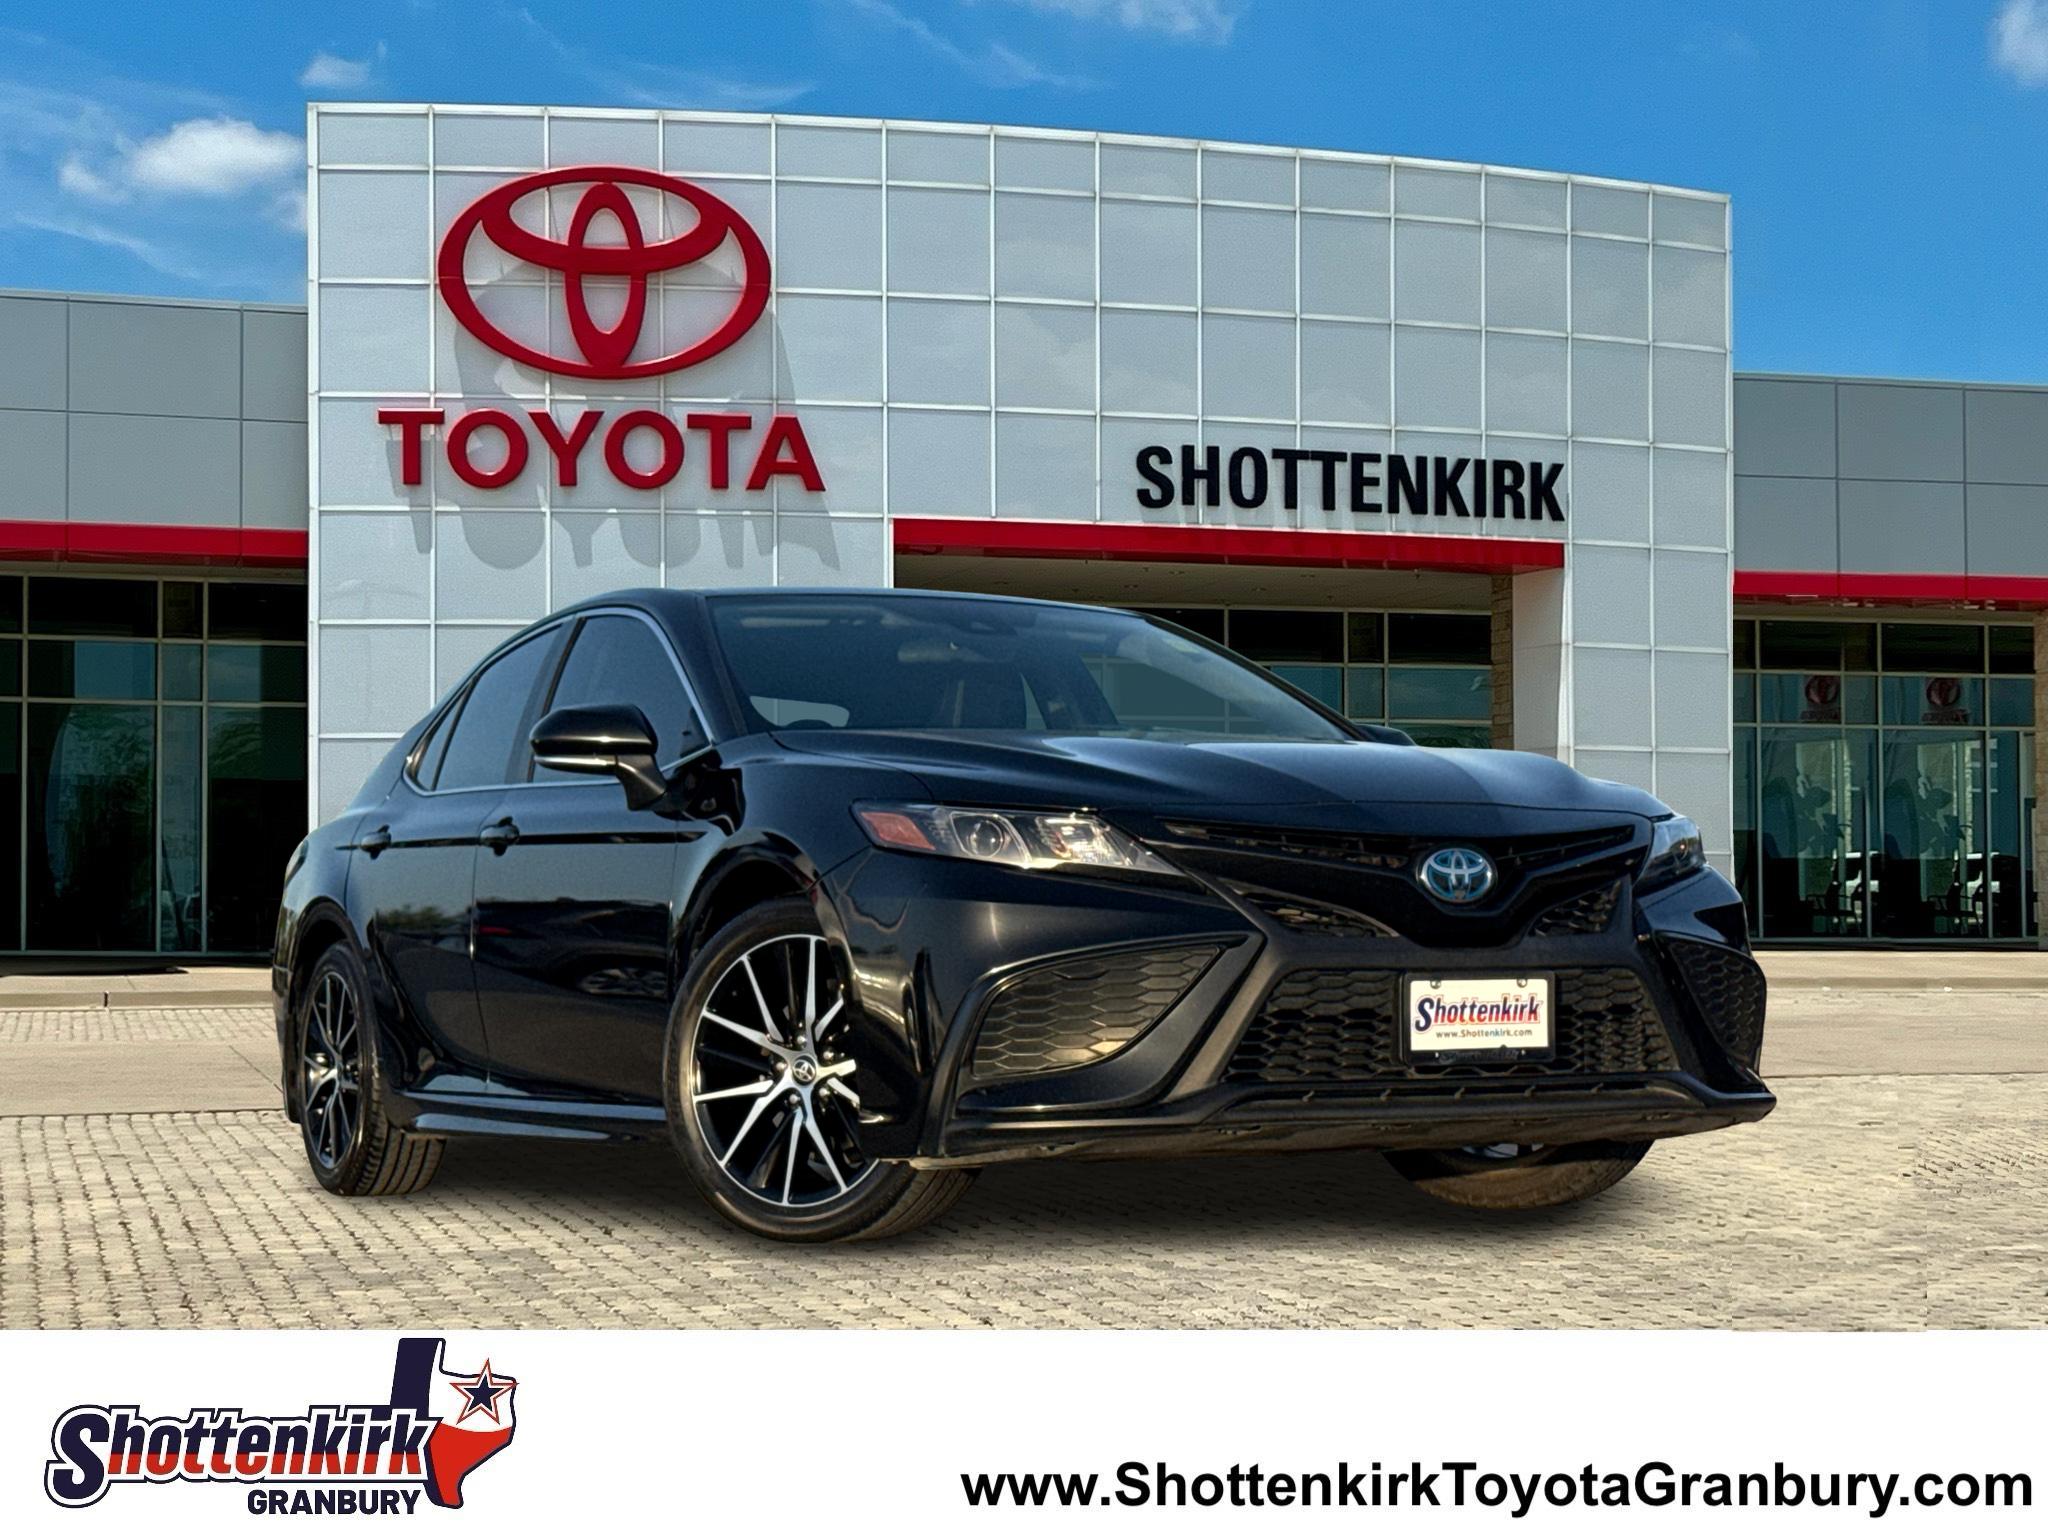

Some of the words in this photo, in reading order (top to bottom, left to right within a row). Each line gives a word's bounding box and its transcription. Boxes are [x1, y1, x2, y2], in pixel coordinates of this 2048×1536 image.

[378, 407, 826, 492] TOYOTA
[1136, 445, 1565, 522] SHOTTENKIRK
[1414, 994, 1542, 1032] Shottenkirk
[1435, 1028, 1533, 1039] www.Shottenkirk.com
